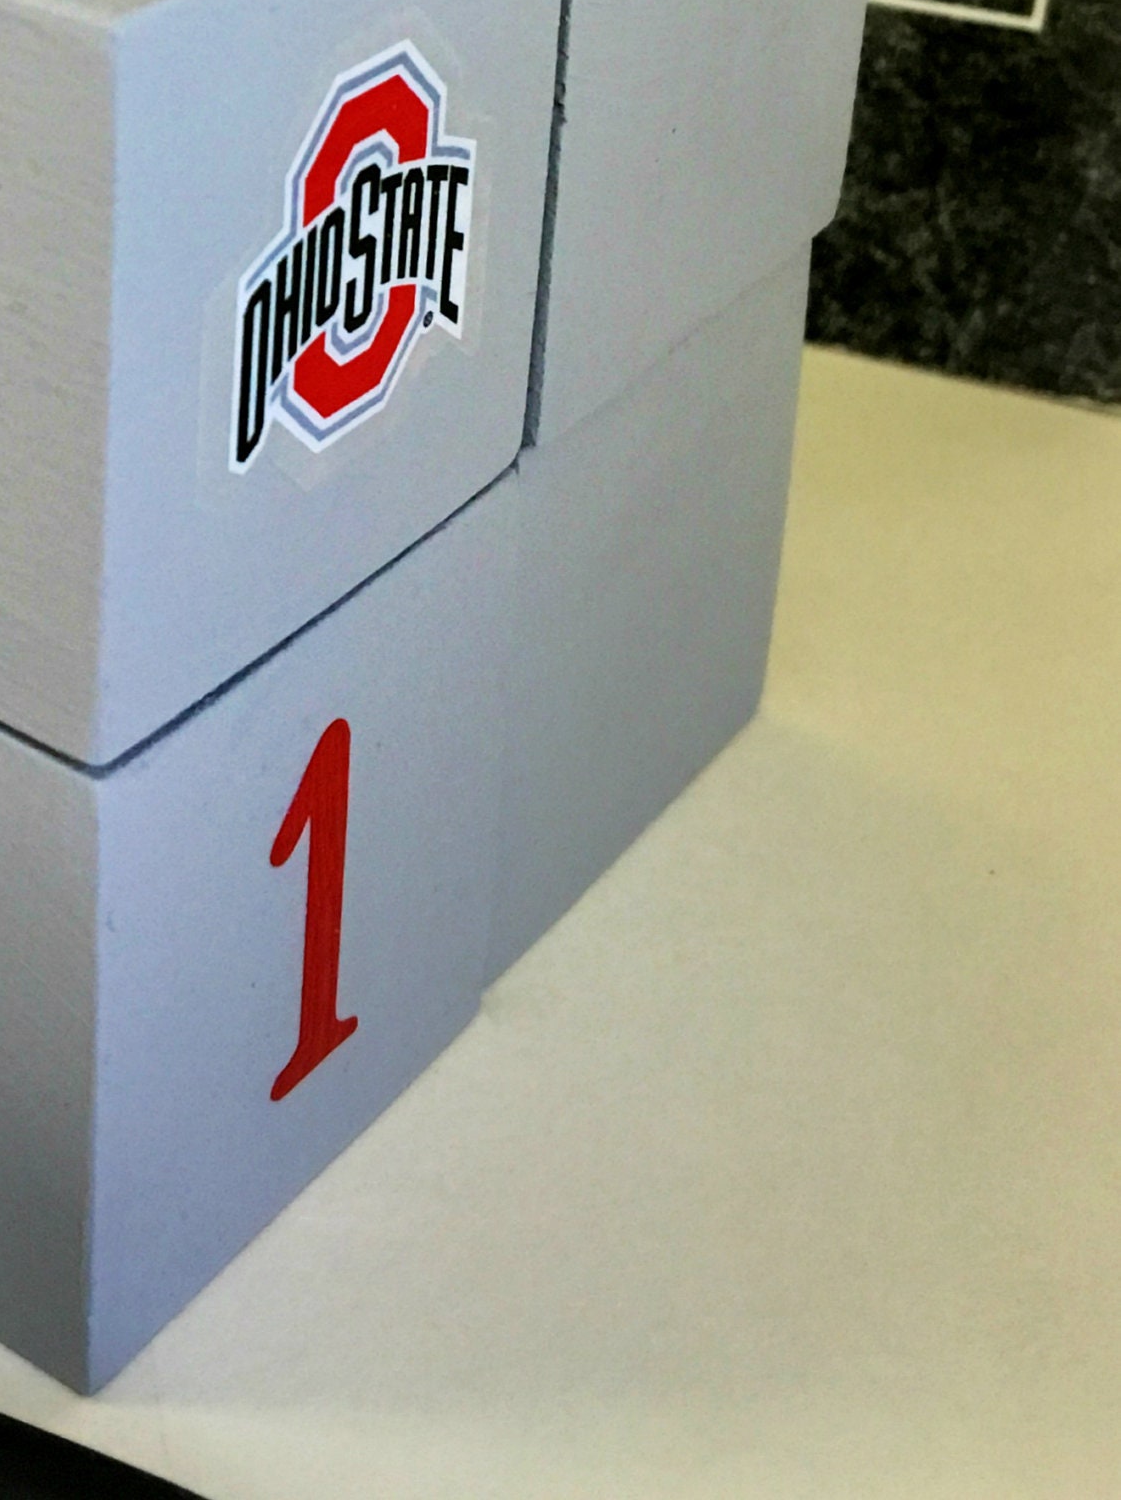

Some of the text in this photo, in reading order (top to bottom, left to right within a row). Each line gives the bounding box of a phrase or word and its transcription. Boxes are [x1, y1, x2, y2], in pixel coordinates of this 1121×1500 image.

[236, 162, 470, 463] OHIO STATE
[268, 717, 359, 1101] 1
